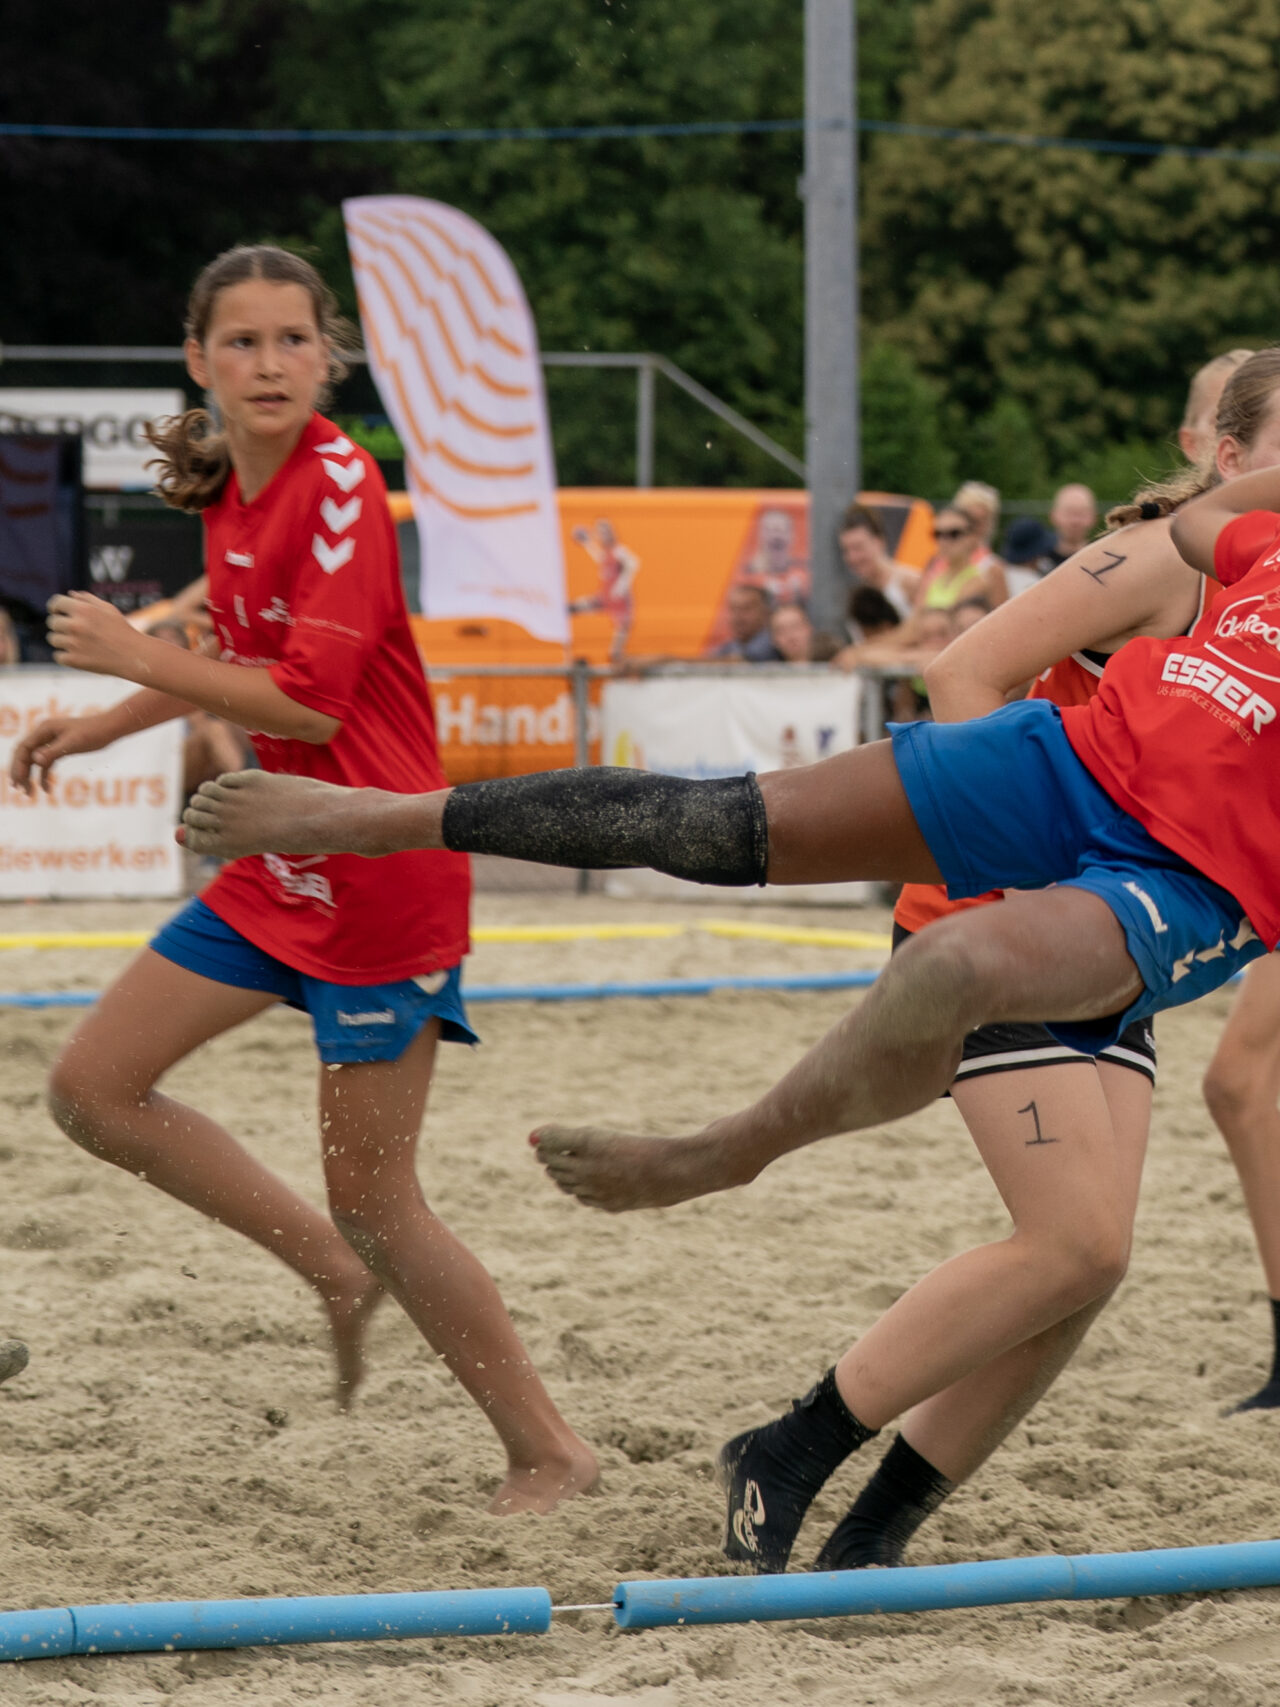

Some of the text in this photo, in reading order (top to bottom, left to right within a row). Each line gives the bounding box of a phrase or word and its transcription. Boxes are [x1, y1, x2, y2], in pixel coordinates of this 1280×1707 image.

[1080, 551, 1127, 587] 1
[1161, 652, 1277, 735] ESSER
[1016, 1100, 1060, 1147] 1
